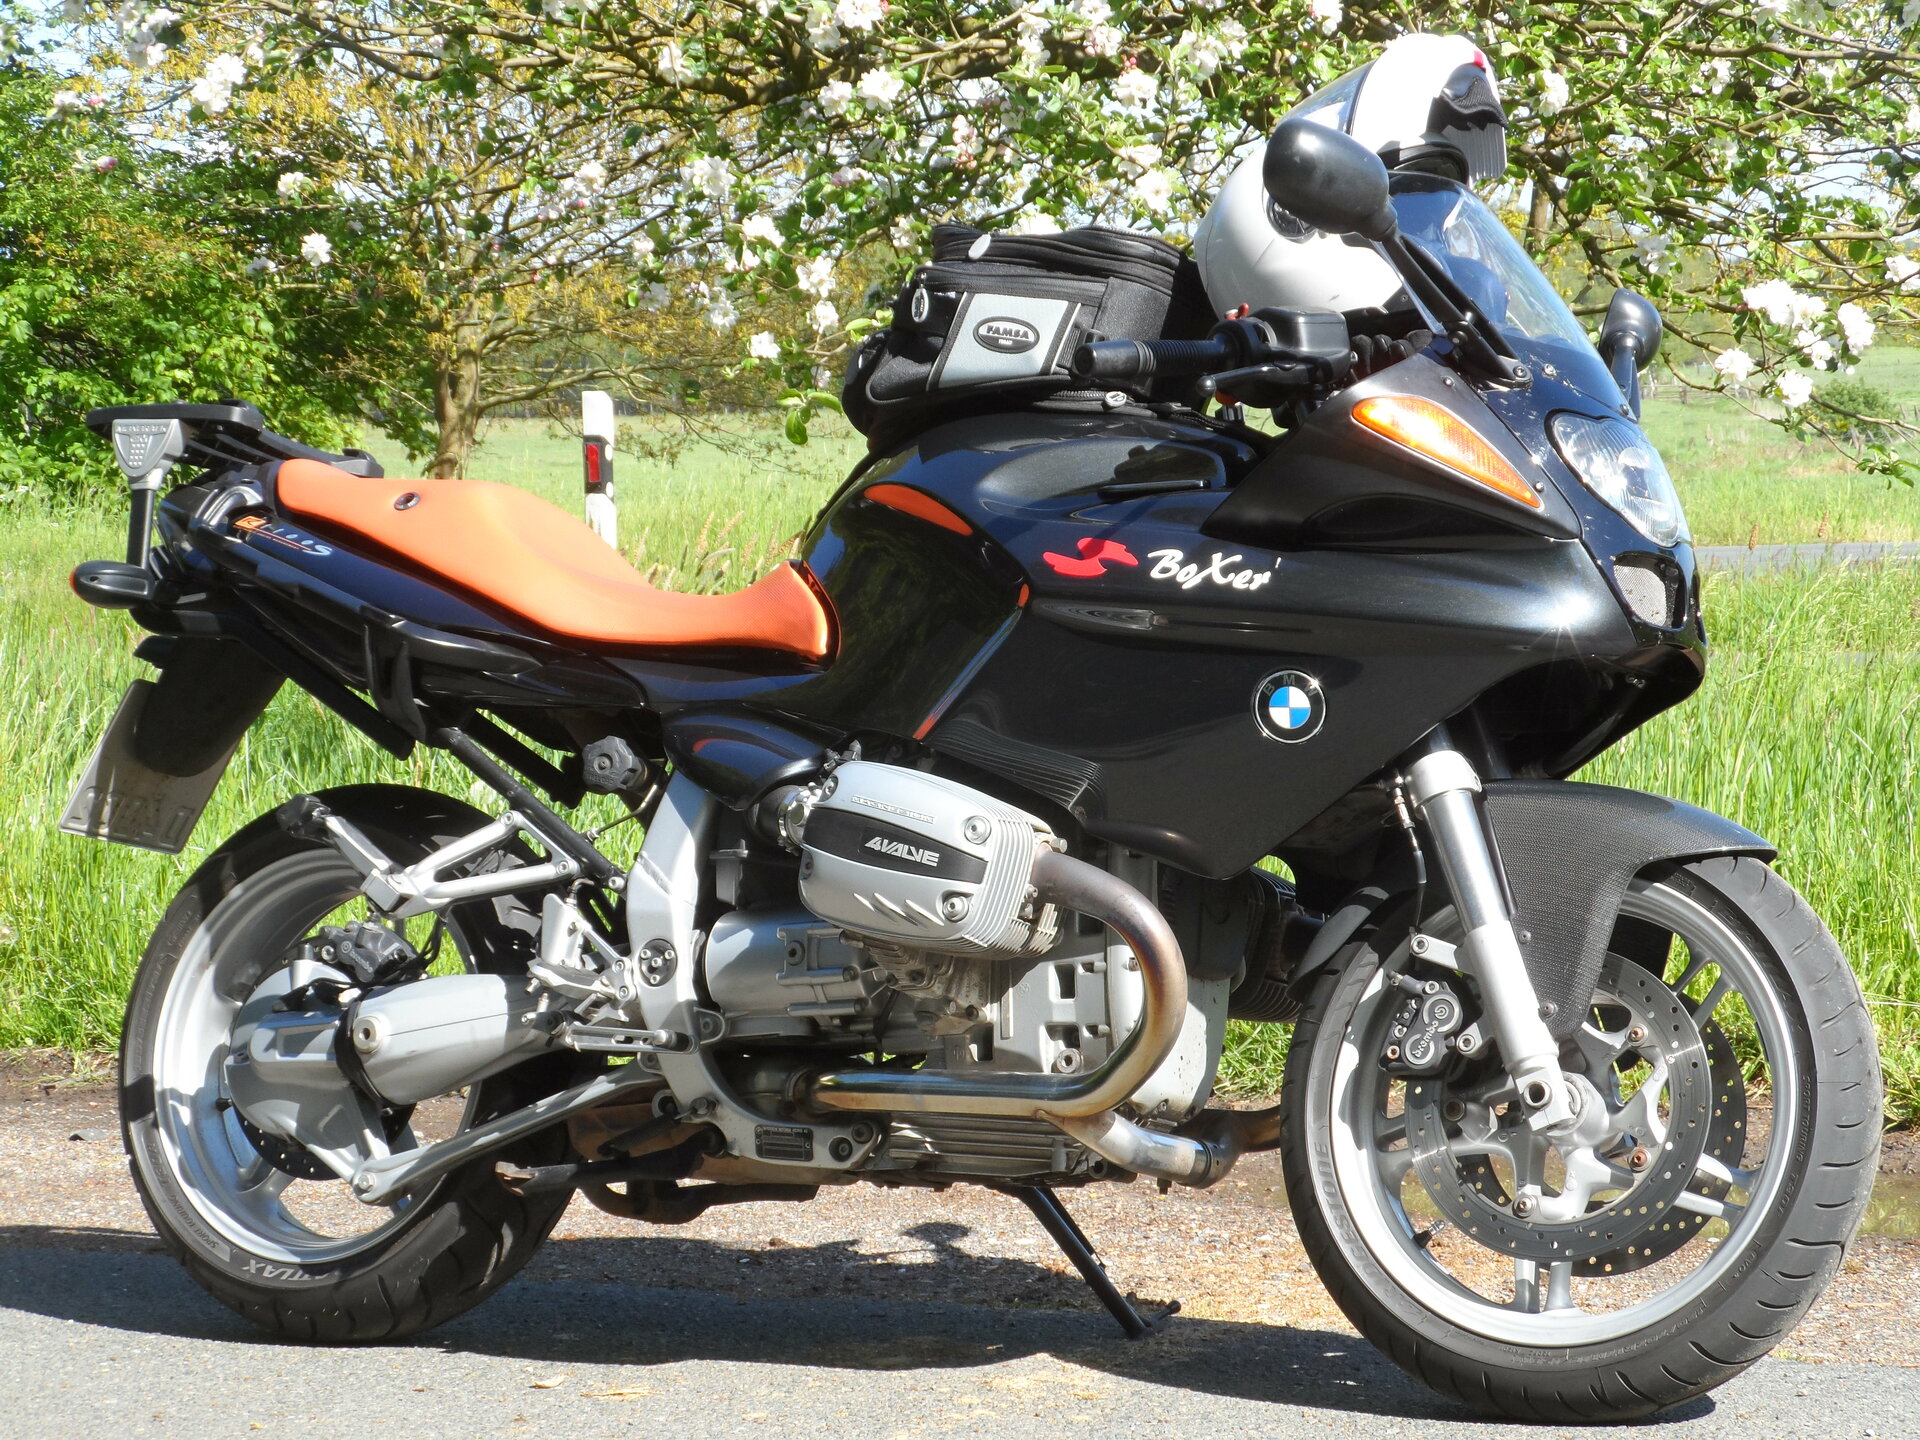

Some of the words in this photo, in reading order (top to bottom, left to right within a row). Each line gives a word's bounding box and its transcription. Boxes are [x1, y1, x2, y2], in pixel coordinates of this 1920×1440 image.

[986, 324, 1030, 340] FAMSA
[1262, 674, 1318, 697] BMW
[864, 836, 940, 868] 4VALVE
[1411, 1019, 1440, 1058] brembo
